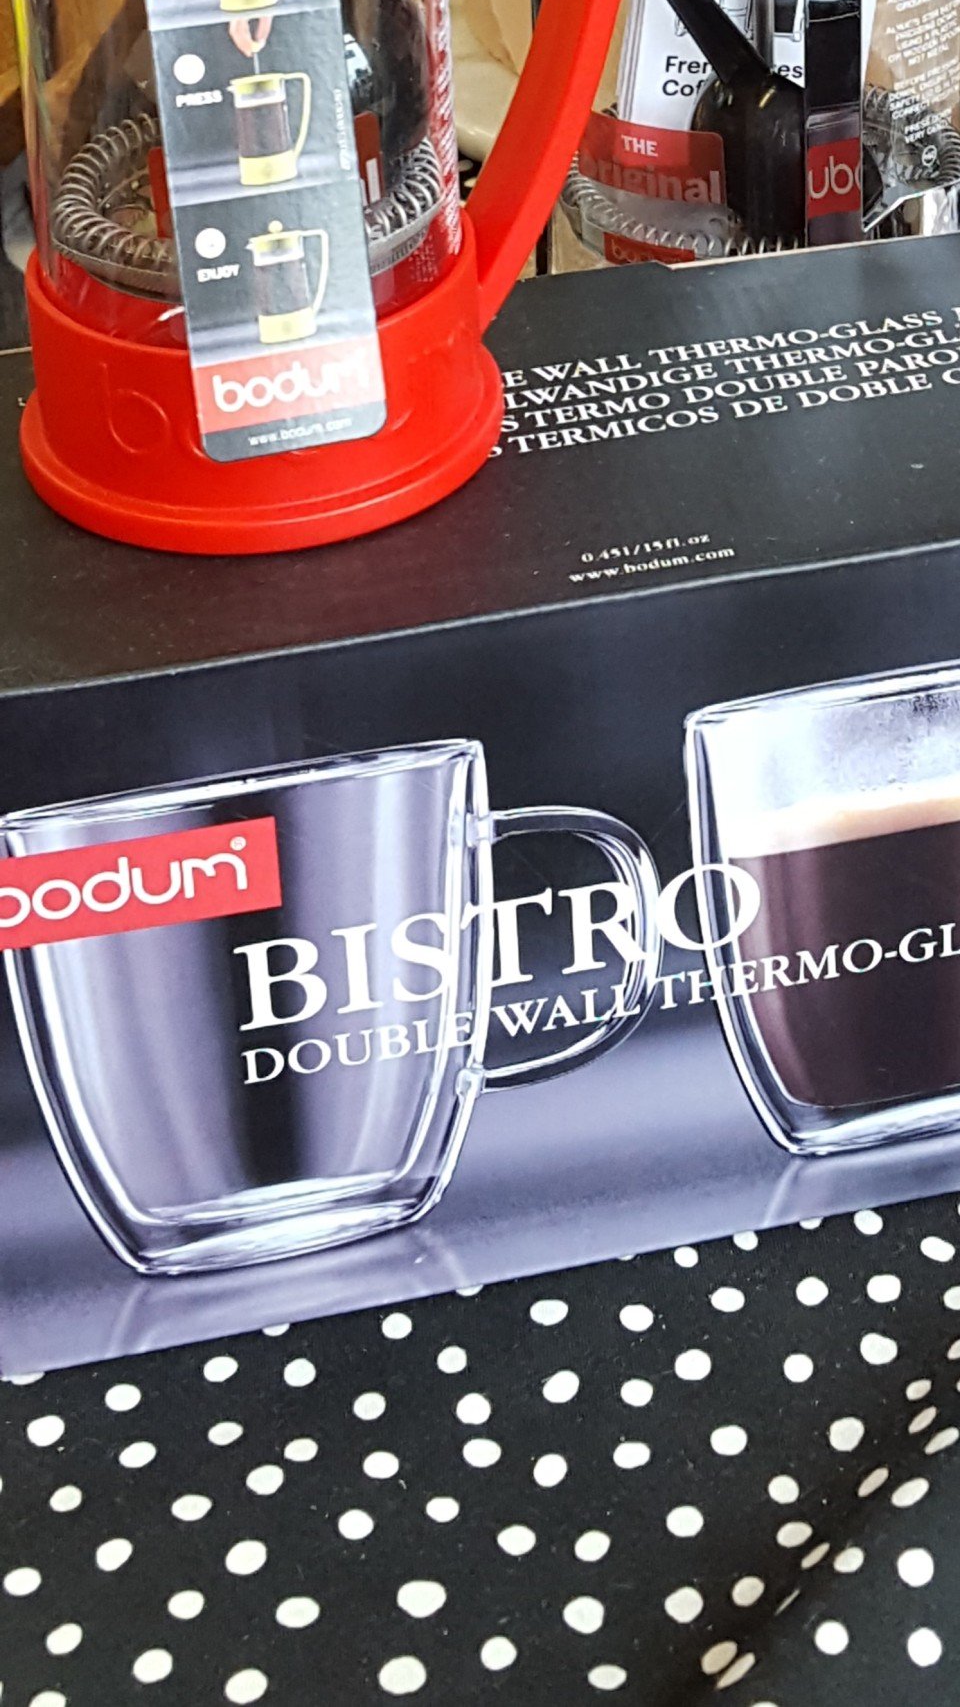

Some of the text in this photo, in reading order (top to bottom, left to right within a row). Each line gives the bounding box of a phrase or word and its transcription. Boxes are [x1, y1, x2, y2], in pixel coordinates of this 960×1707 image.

[621, 134, 659, 158] THE
[531, 352, 641, 383] WALL
[648, 309, 943, 367] THERMO-GLASS
[211, 348, 371, 414] bodum
[504, 362, 718, 410] LWANDIGE
[507, 404, 720, 454] TERMICOS
[731, 393, 789, 420] DE
[800, 372, 933, 410] DOBLE
[525, 391, 671, 429] TERMO
[684, 363, 847, 403] DOUBLE
[568, 547, 736, 584] www.bodum.com
[232, 862, 762, 1032] BISTRO
[240, 1010, 473, 1085] DOUBLE
[491, 983, 641, 1039] WALL
